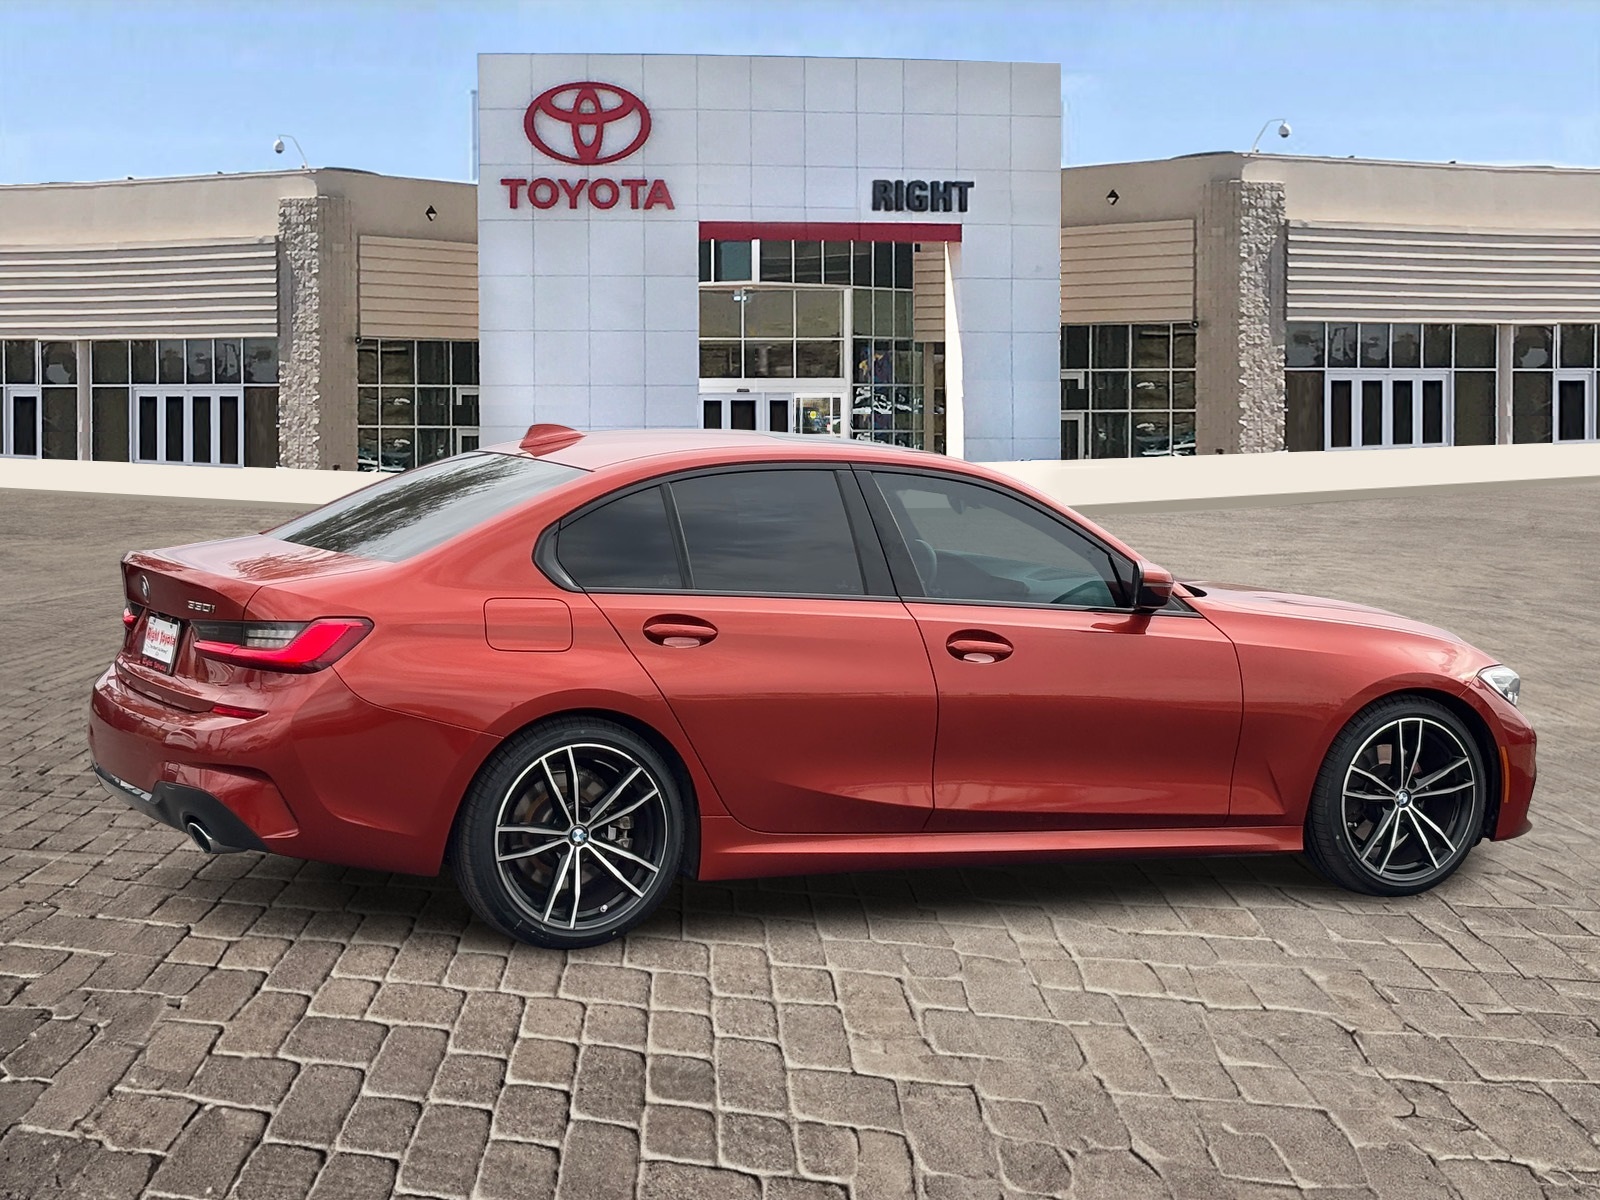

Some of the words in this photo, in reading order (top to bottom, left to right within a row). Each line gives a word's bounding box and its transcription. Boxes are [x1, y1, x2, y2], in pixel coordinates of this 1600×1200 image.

[500, 177, 675, 210] TOYOTA
[871, 179, 975, 213] RIGHT
[187, 600, 216, 613] 330i
